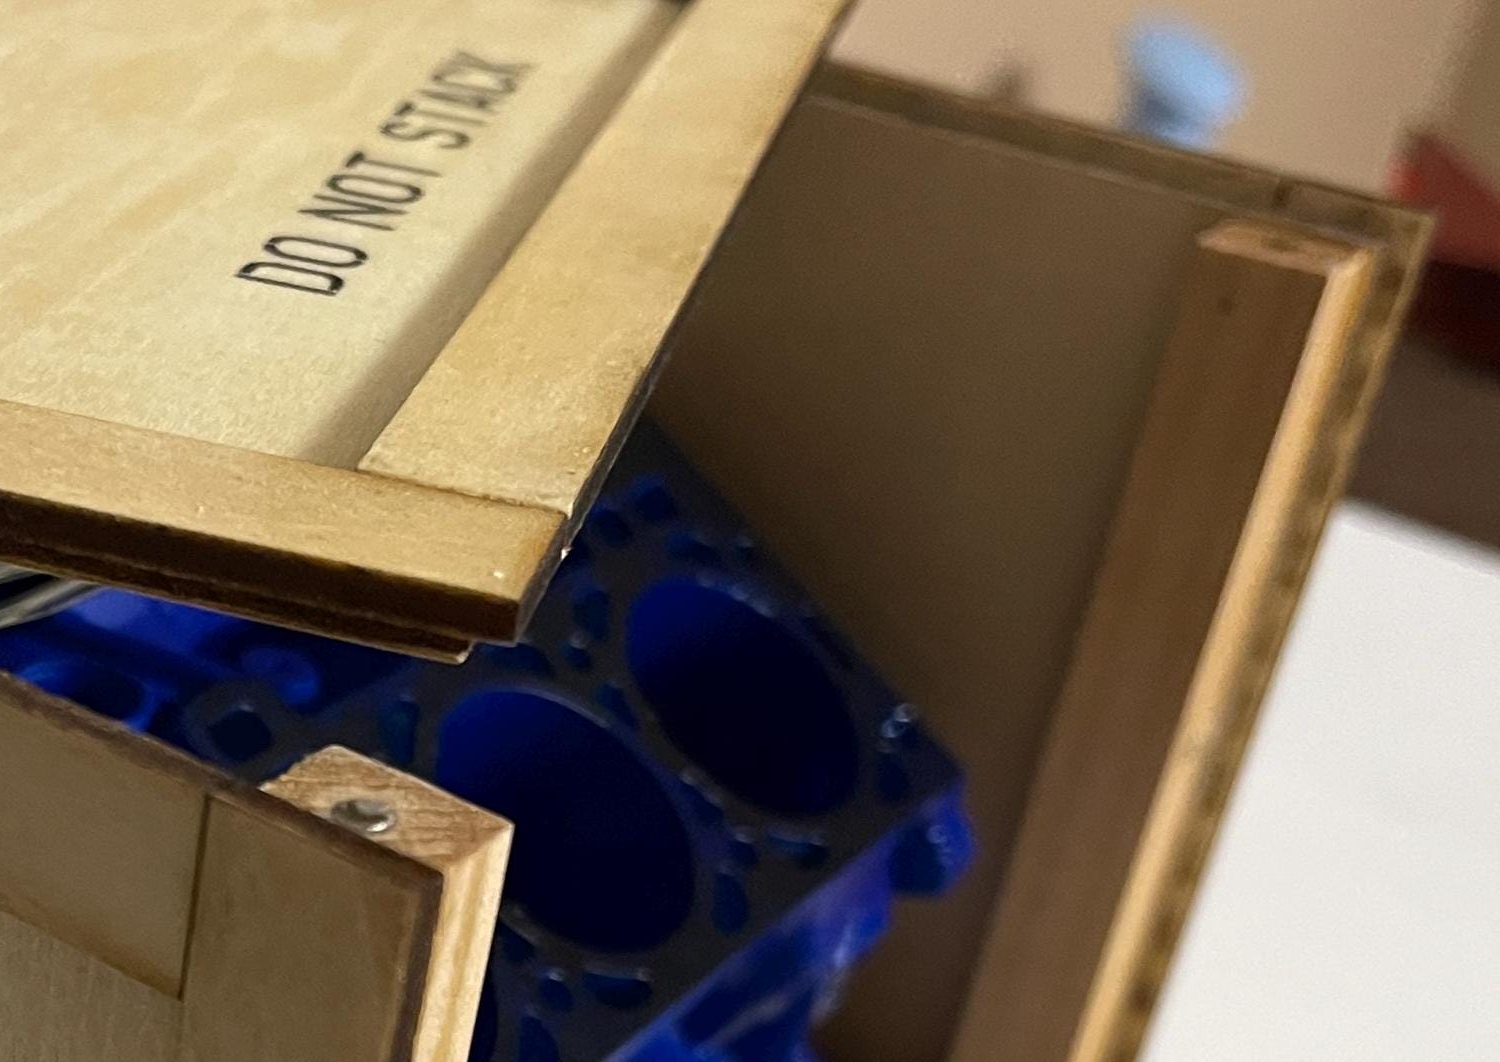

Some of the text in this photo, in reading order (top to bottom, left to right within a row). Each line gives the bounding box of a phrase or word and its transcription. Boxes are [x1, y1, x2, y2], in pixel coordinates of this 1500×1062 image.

[234, 49, 532, 297] DO NOT STACK
